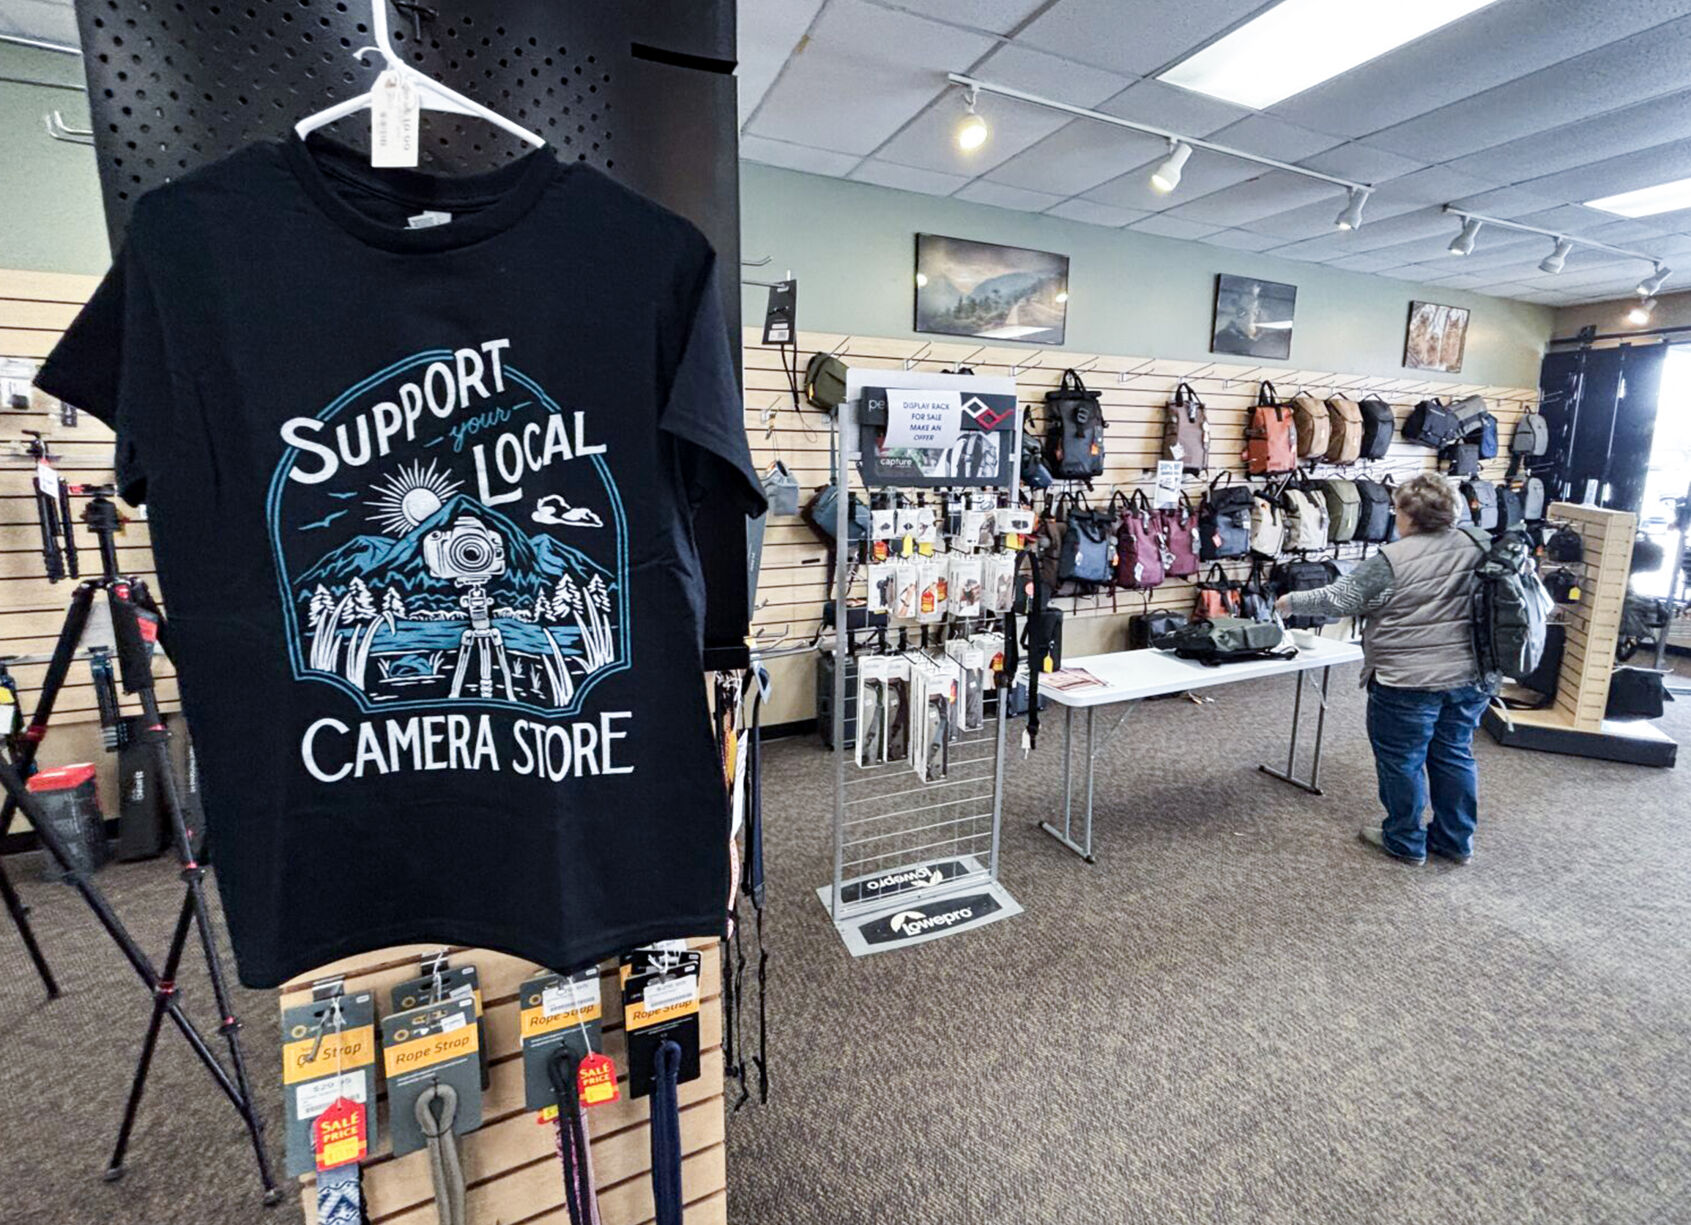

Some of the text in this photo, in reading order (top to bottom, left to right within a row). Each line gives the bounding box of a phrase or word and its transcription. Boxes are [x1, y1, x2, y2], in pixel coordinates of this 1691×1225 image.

[281, 338, 510, 484] SUPPORT
[903, 401, 950, 411] DISPLAY RACK
[911, 413, 942, 422] FOR SALE
[450, 406, 511, 453] your
[473, 411, 607, 507] LOCAL
[880, 458, 912, 466] capture
[302, 711, 634, 782] CAMERA STORE
[902, 908, 972, 936] Lowepro
[529, 1012, 560, 1027] Rope
[632, 1006, 662, 1021] Rope
[396, 1035, 470, 1065] Rope Strap
[579, 1063, 611, 1080] SALE
[582, 1074, 610, 1087] PRICE
[320, 1110, 360, 1134] SALE
[323, 1127, 359, 1144] PRICE
